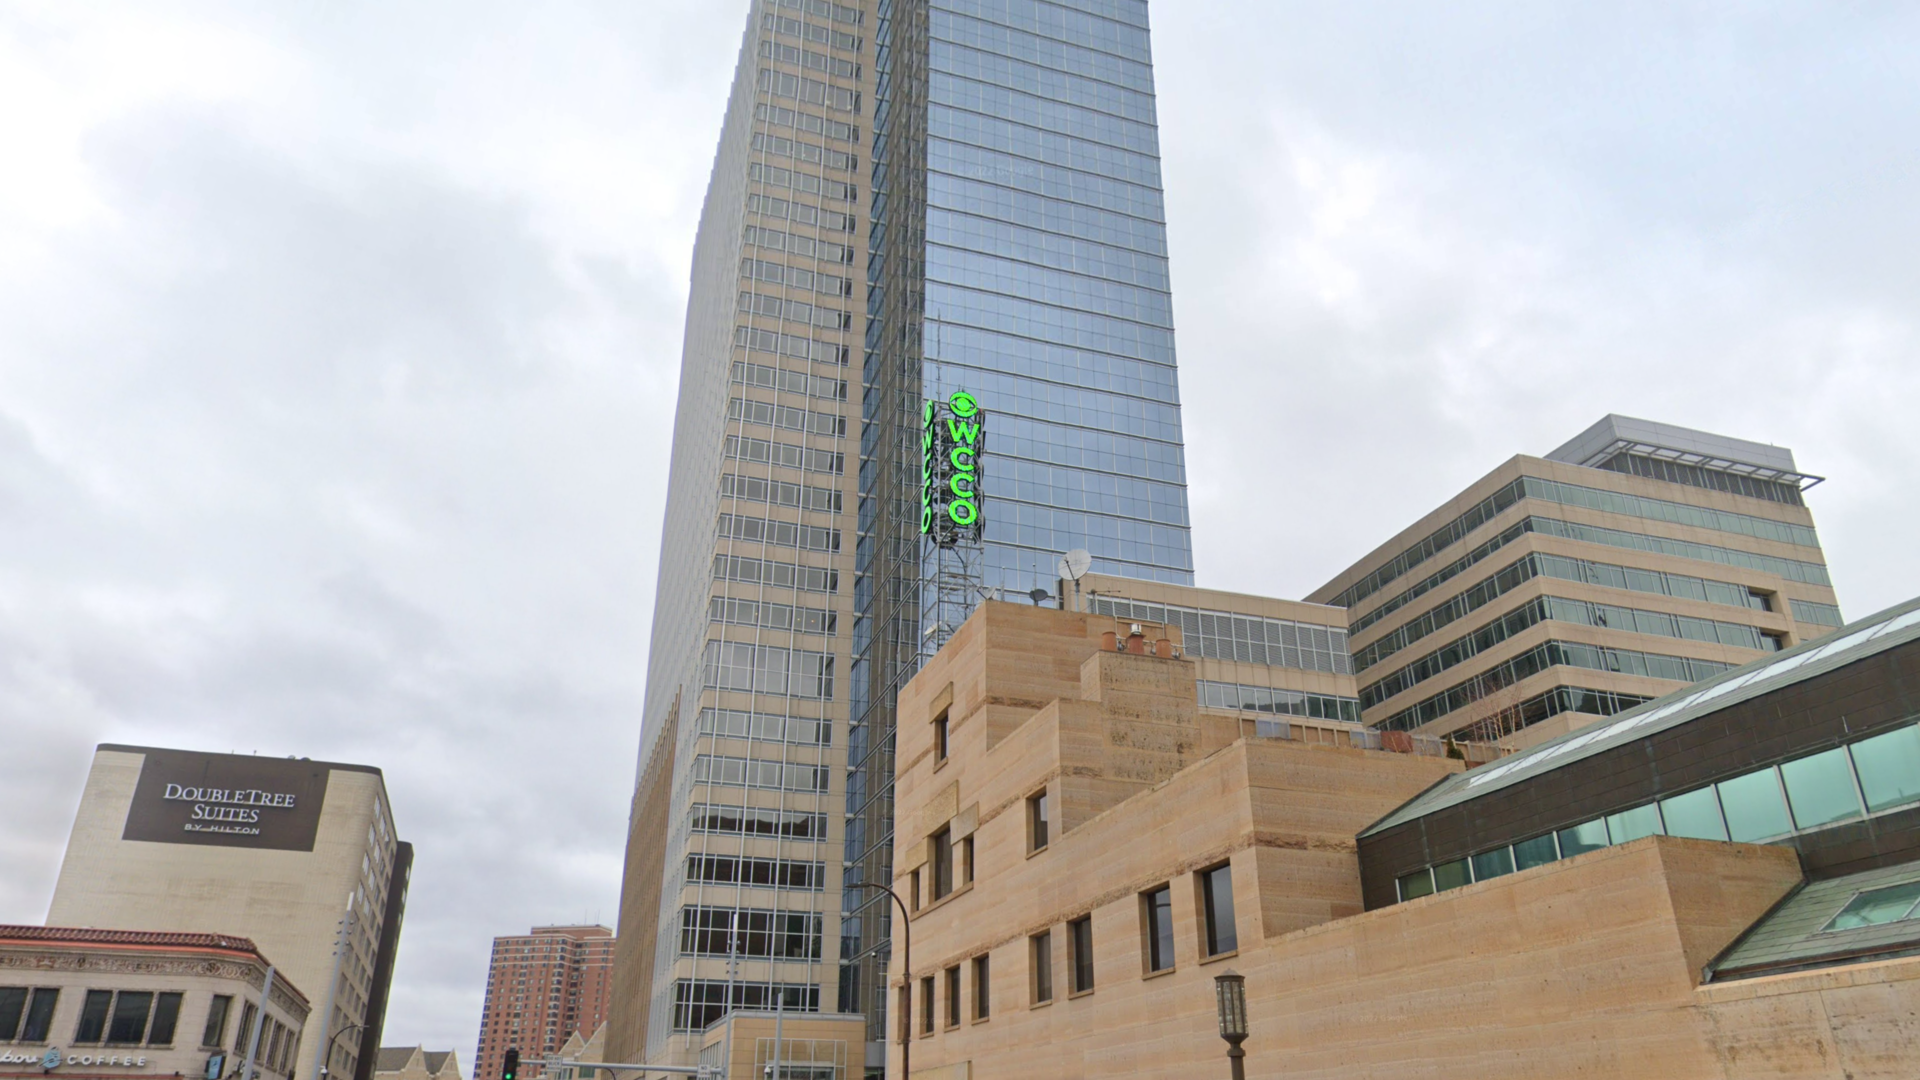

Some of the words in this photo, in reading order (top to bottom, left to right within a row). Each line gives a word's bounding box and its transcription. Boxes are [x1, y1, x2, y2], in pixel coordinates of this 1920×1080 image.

[947, 419, 980, 526] WCCO
[163, 783, 296, 808] DOUBLETREE
[191, 803, 260, 823] SUITES
[184, 823, 202, 831] BY
[210, 825, 260, 835] HILTON
[67, 1054, 146, 1066] COFFEE
